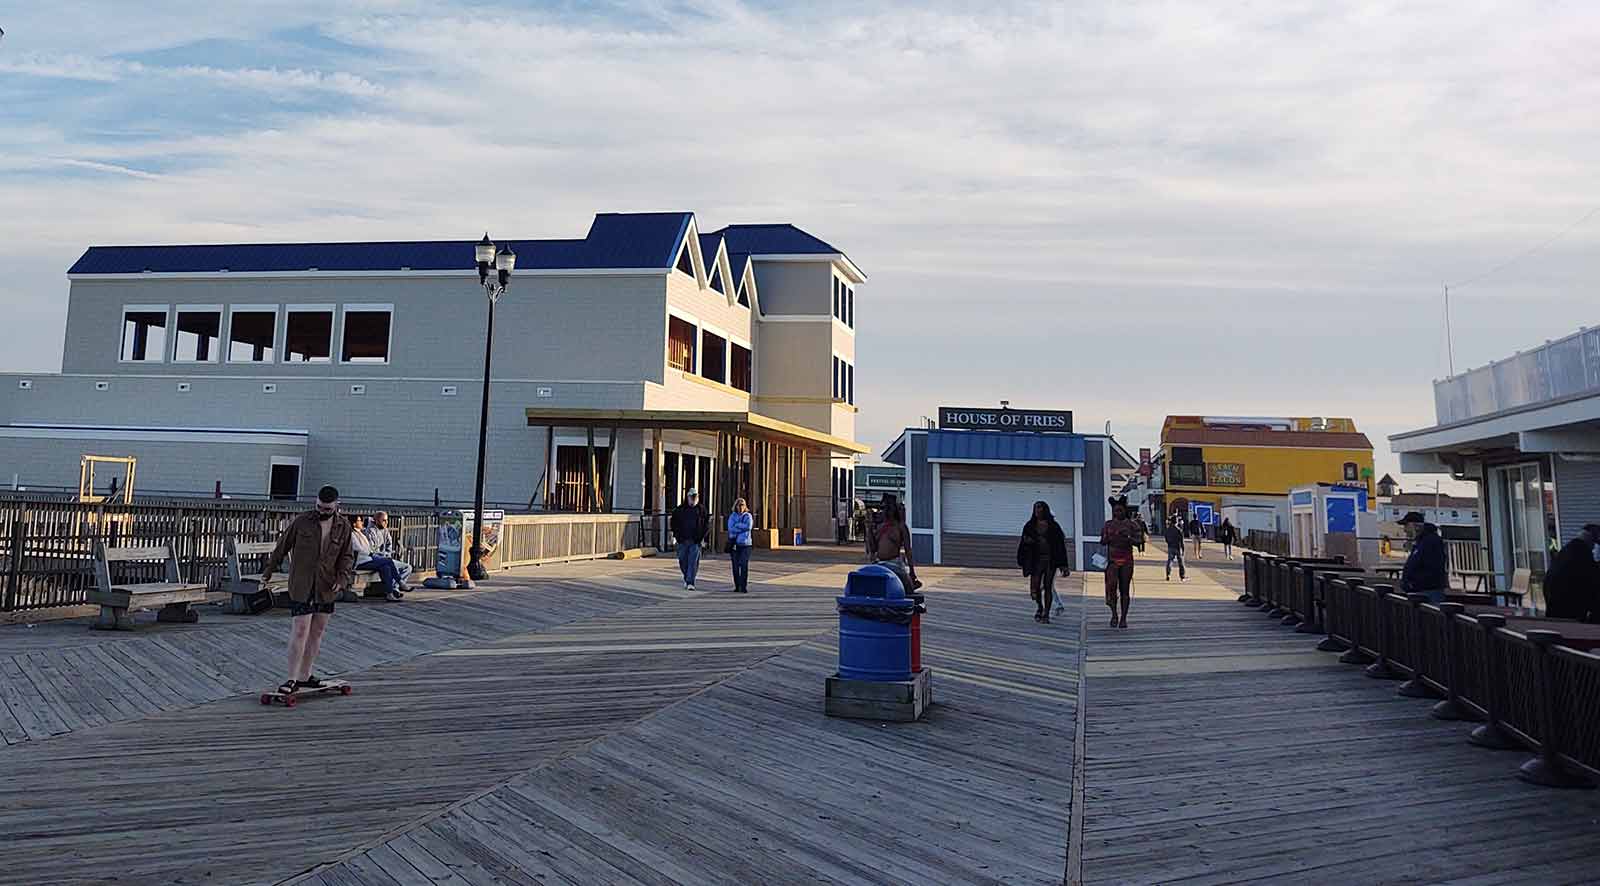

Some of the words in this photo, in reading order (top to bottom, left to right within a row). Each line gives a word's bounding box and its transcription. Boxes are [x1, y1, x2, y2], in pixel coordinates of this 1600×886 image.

[946, 412, 998, 425] HOUSE
[1000, 414, 1021, 425] OF
[1023, 415, 1065, 427] FRIES
[1210, 475, 1241, 485] TACOS
